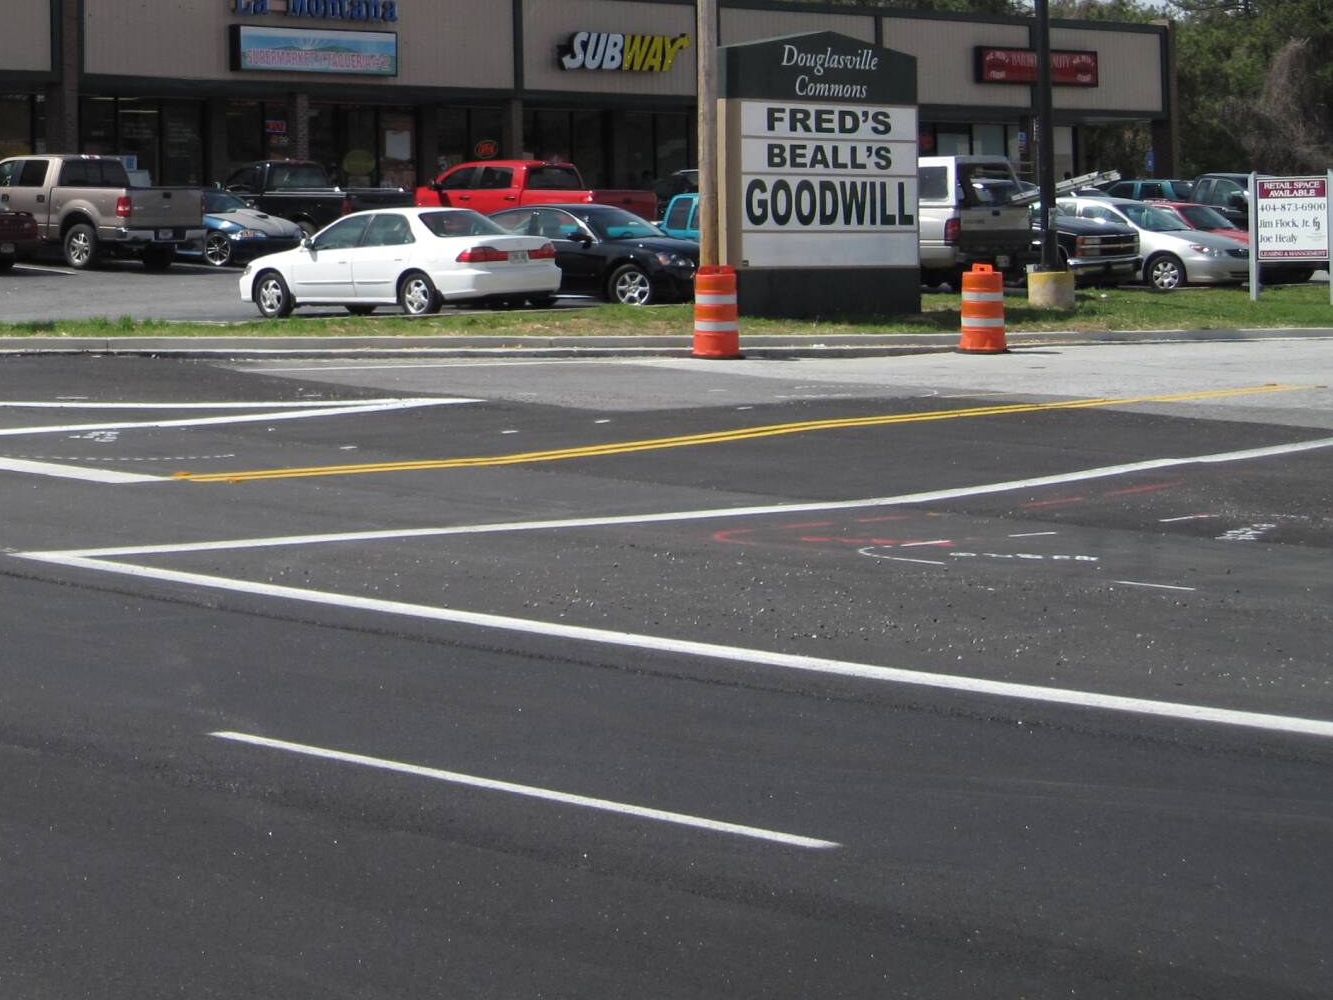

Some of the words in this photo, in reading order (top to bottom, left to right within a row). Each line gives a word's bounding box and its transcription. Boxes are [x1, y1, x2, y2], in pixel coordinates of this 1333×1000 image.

[562, 31, 692, 73] SUBWAY
[781, 44, 879, 75] Douglasville
[795, 75, 868, 98] Commons
[766, 107, 892, 135] FRED'S
[767, 143, 892, 170] BEALL'S
[1264, 182, 1293, 190] RETAIL
[1293, 180, 1321, 189] SPACE
[1268, 189, 1316, 198] AVAILABLE
[745, 178, 915, 226] GOODWILL
[1260, 203, 1326, 213] 404-873-6900
[1259, 219, 1274, 229] Jim
[1260, 234, 1274, 244] Joe
[1275, 233, 1299, 245] Healy
